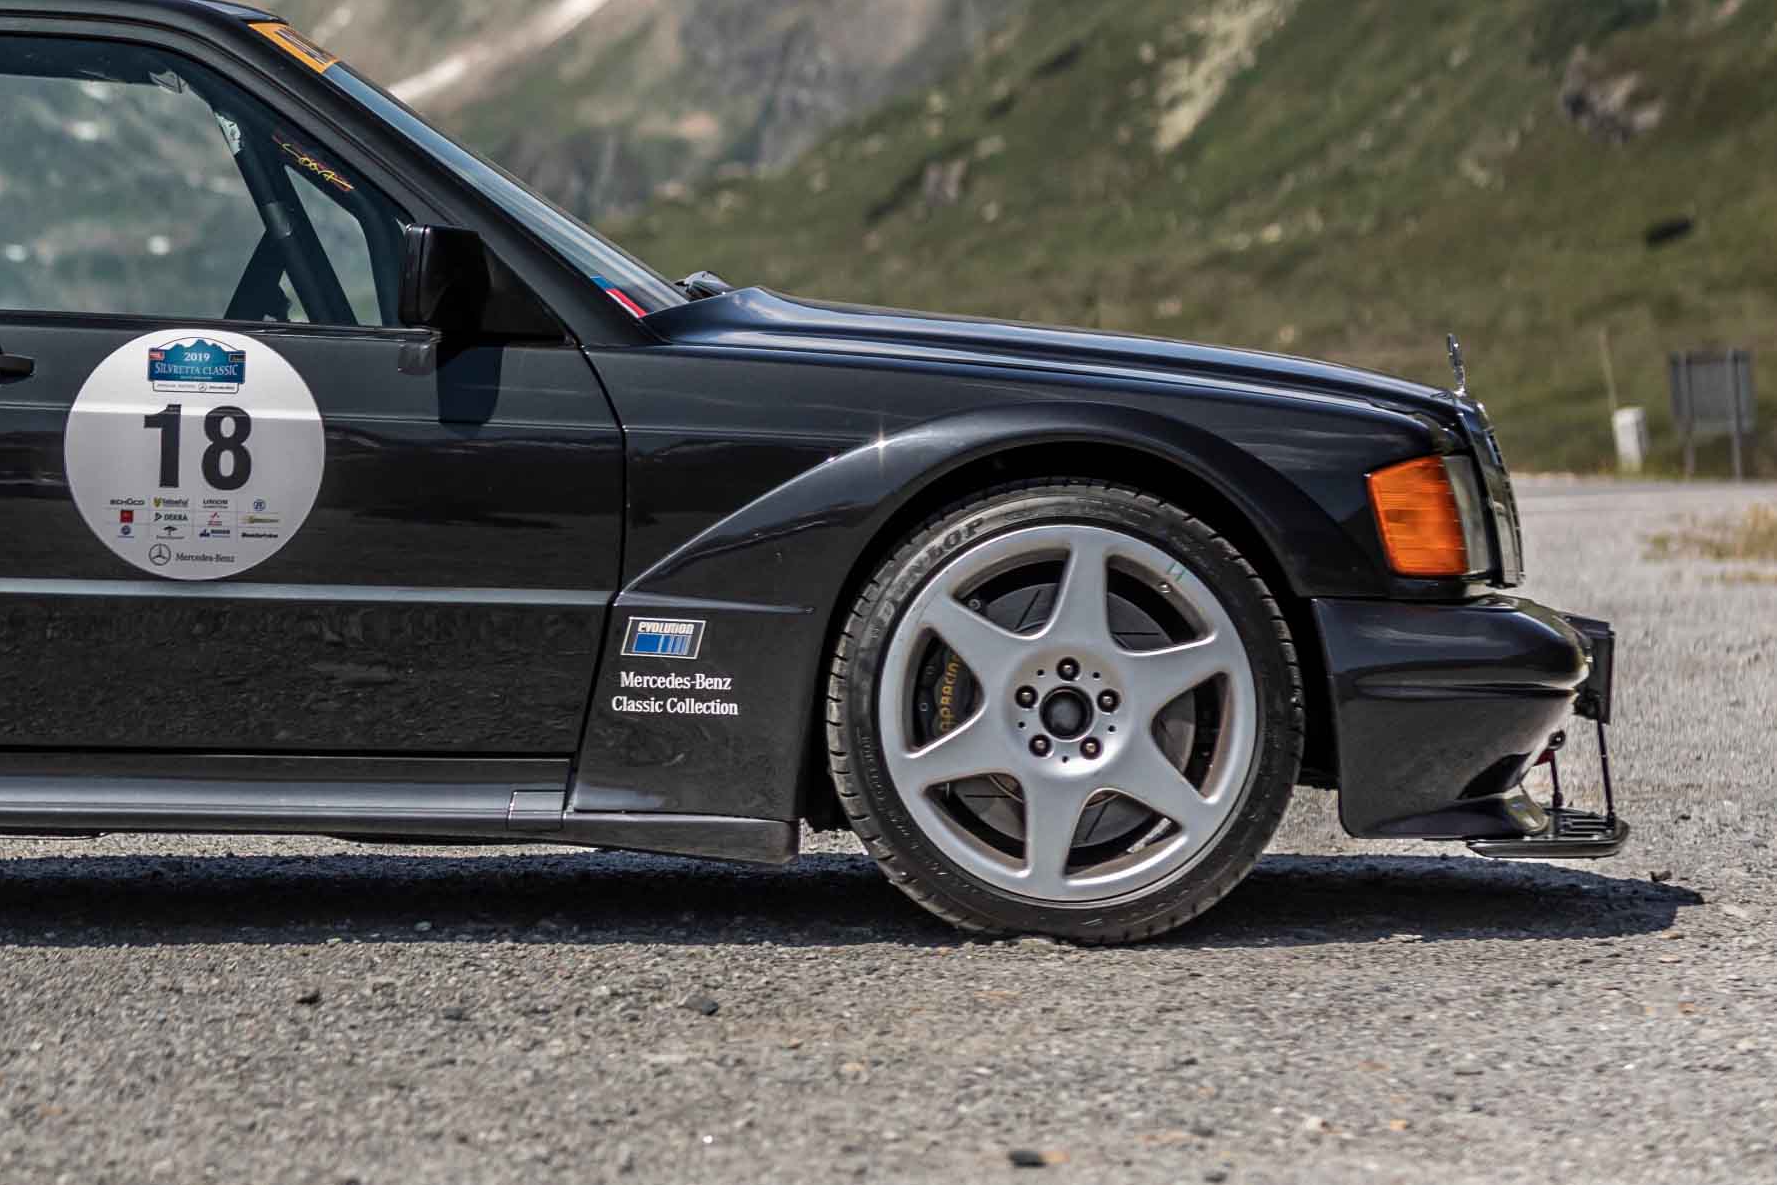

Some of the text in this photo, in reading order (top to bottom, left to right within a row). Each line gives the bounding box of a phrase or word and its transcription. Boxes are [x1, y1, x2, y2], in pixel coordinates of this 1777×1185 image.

[184, 351, 211, 362] 2019
[202, 364, 238, 376] CLASSIC
[143, 404, 252, 491] 18
[620, 671, 732, 690] Mercedes-Benz
[611, 695, 739, 716] Classic Collection
